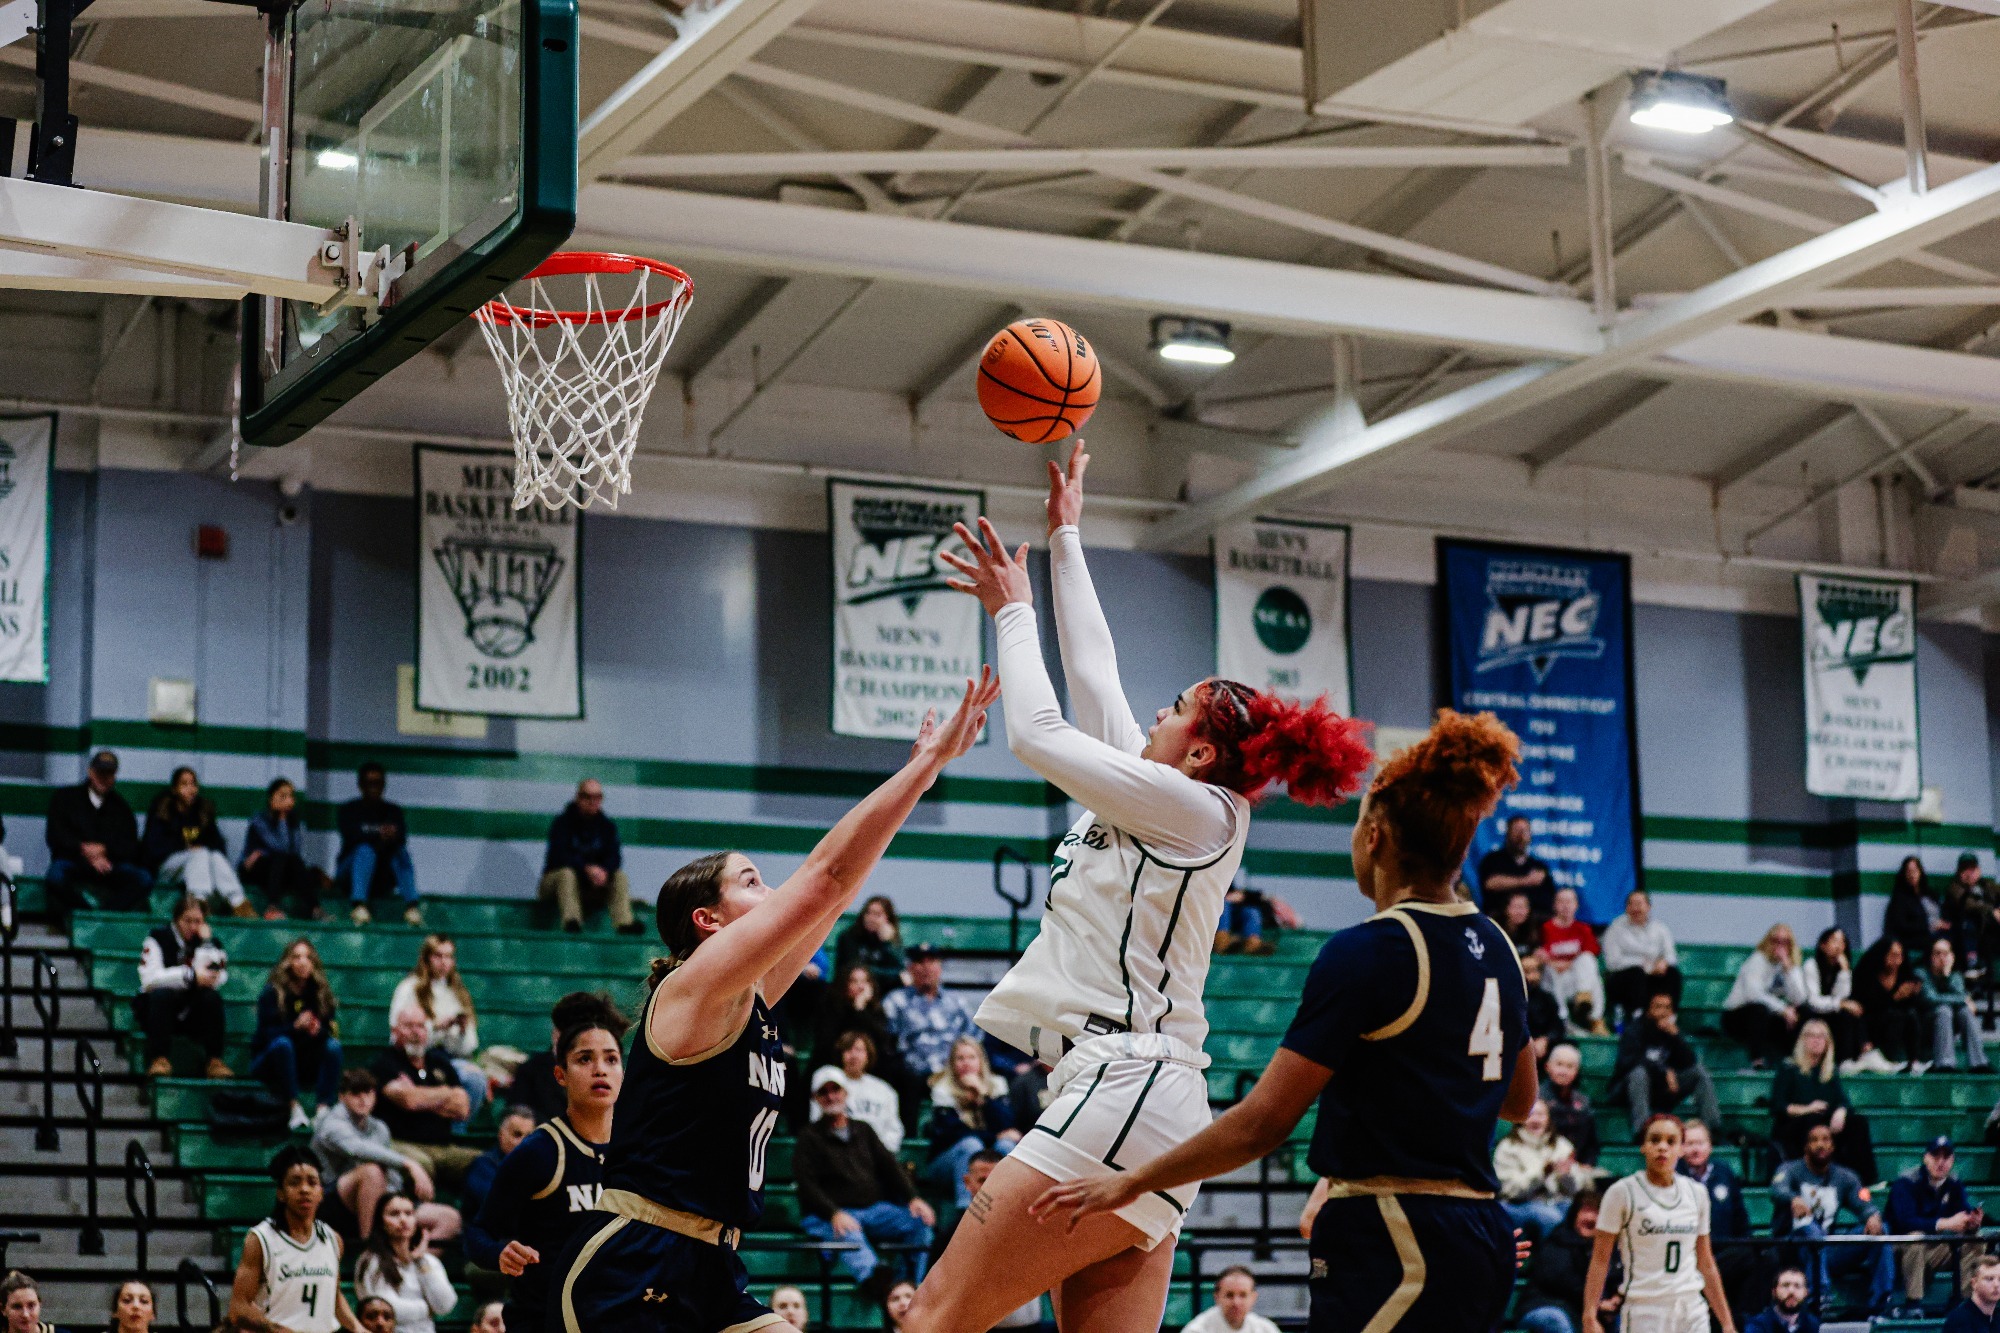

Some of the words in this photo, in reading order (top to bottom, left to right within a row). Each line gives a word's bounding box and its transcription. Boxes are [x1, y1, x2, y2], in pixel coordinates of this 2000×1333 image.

[425, 489, 573, 525] BASKETBALL
[848, 534, 978, 587] NEC
[1229, 548, 1338, 583] BASKETBALL
[876, 624, 942, 646] MEN'S
[1481, 592, 1601, 654] NEC
[1811, 612, 1908, 658] NEC
[466, 661, 531, 692] 2002
[840, 649, 975, 675] BASKETBALL
[1468, 977, 1504, 1082] 4
[748, 1106, 780, 1192] 10
[1664, 1240, 1680, 1274] 0
[302, 1283, 318, 1317] 4
